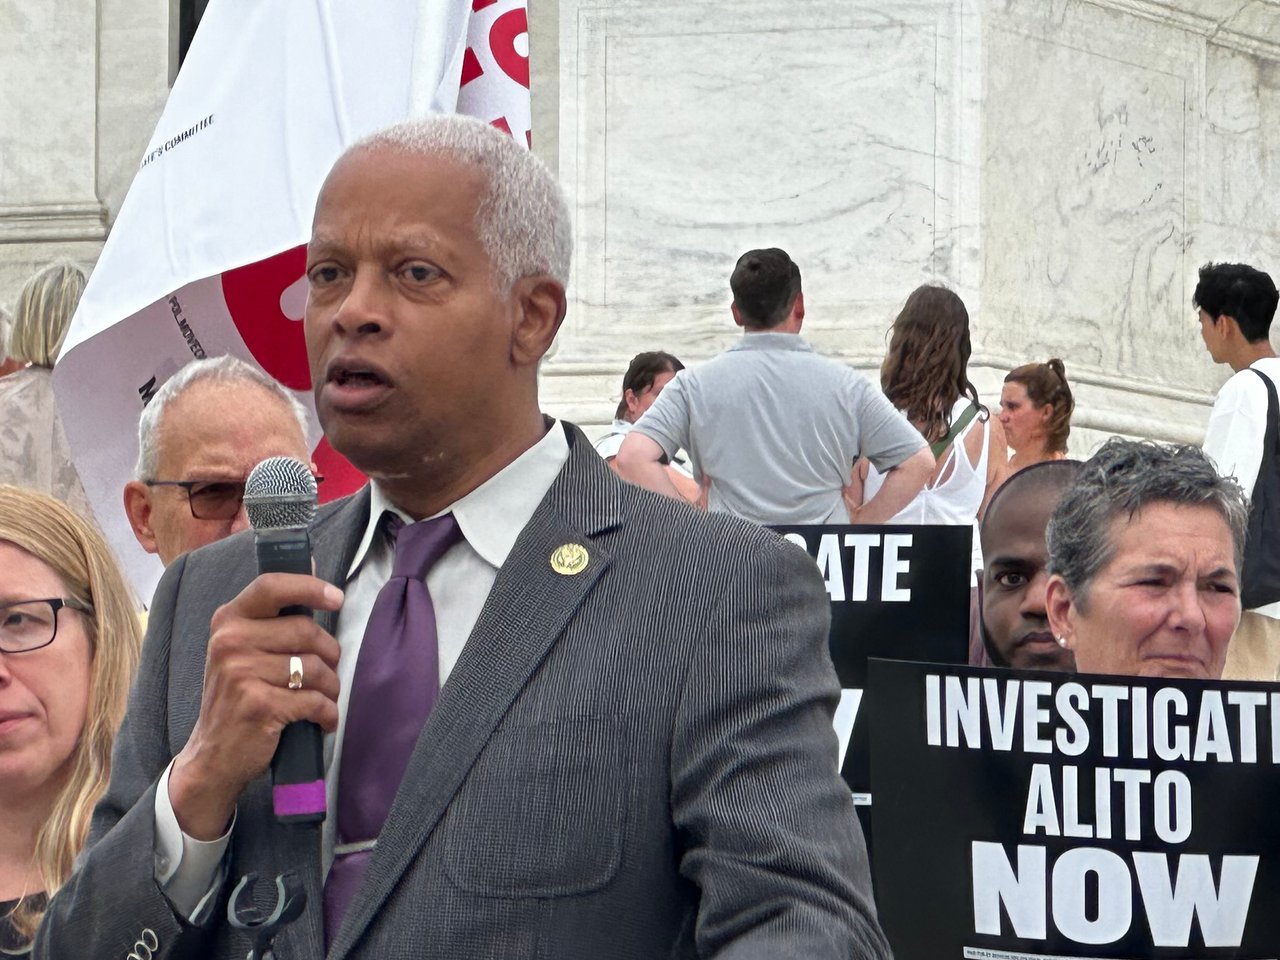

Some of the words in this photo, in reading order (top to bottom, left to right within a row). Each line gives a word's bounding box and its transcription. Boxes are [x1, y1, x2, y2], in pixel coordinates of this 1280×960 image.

[784, 533, 913, 602] ATE
[1023, 763, 1193, 844] ALITO
[971, 840, 1261, 948] NOW
